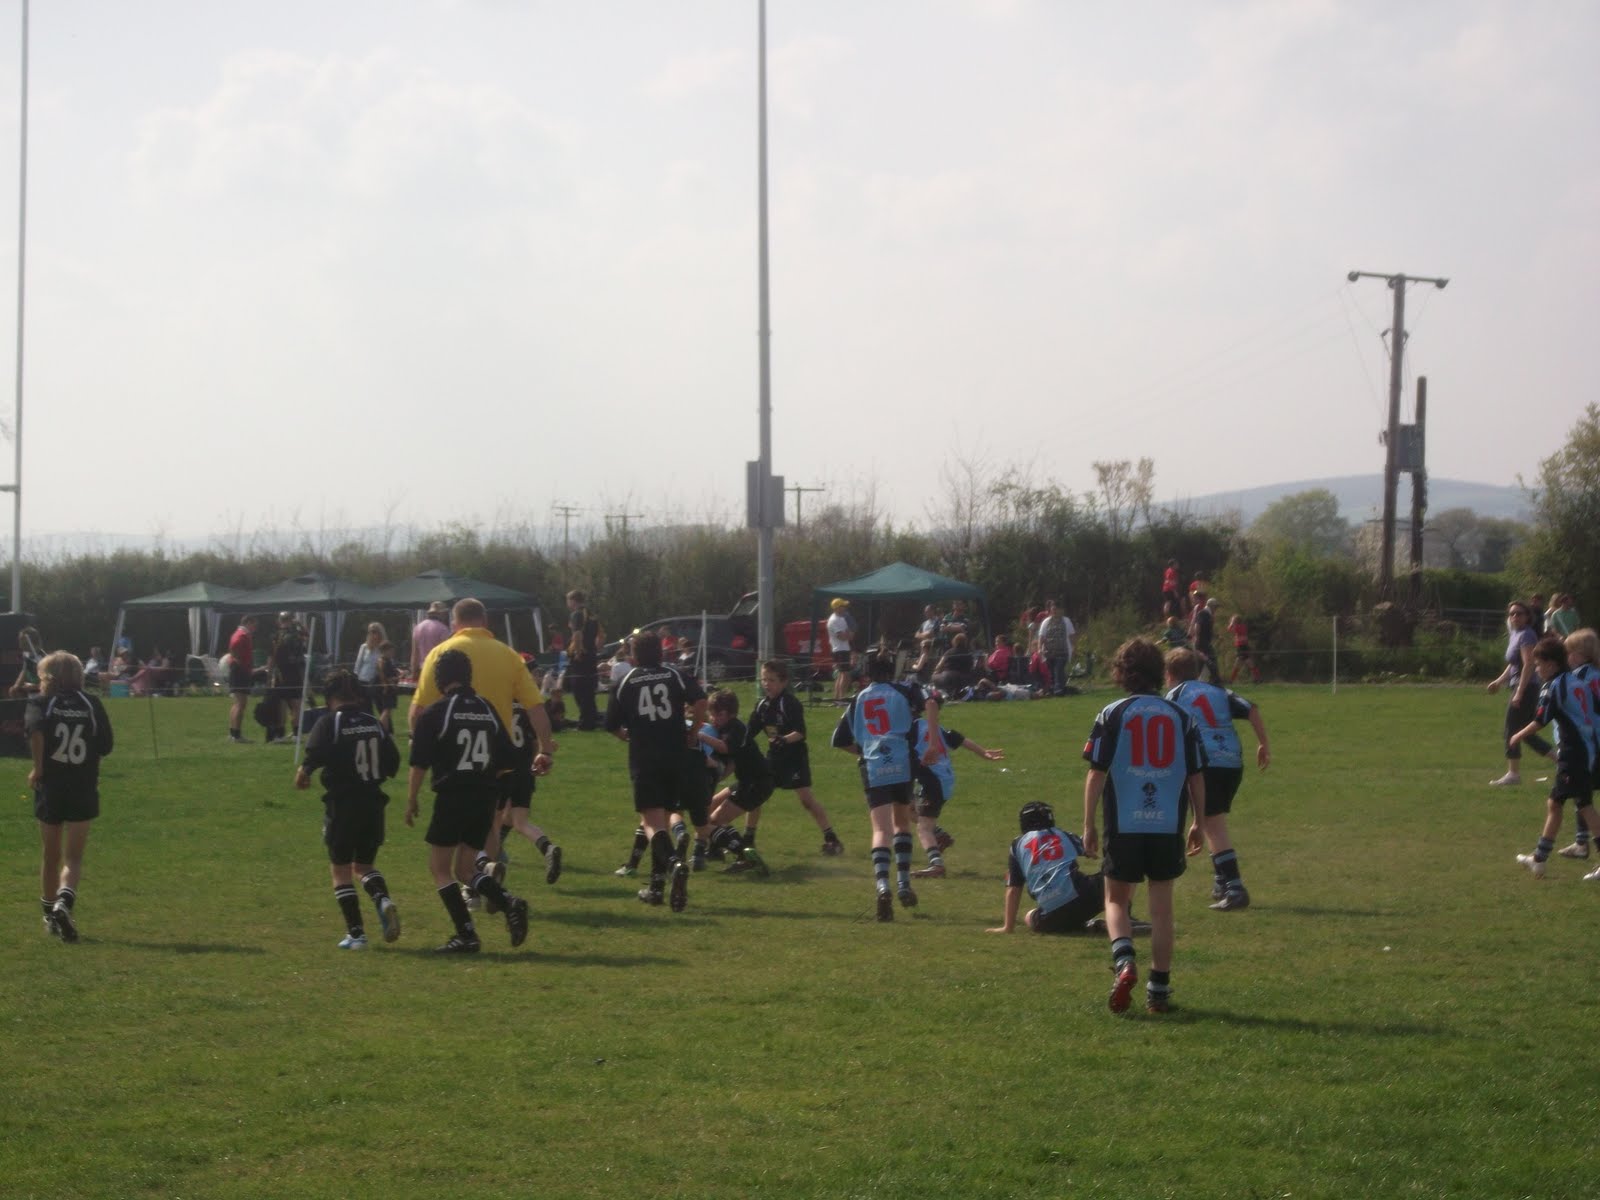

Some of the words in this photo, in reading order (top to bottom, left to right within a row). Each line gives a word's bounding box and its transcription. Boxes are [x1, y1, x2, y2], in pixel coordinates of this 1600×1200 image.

[638, 683, 672, 721] 43
[863, 698, 890, 736] 5
[1191, 694, 1216, 729] 1
[51, 722, 87, 764] 26
[355, 737, 380, 781] 41
[456, 728, 490, 770] 24
[1124, 714, 1176, 768] 10
